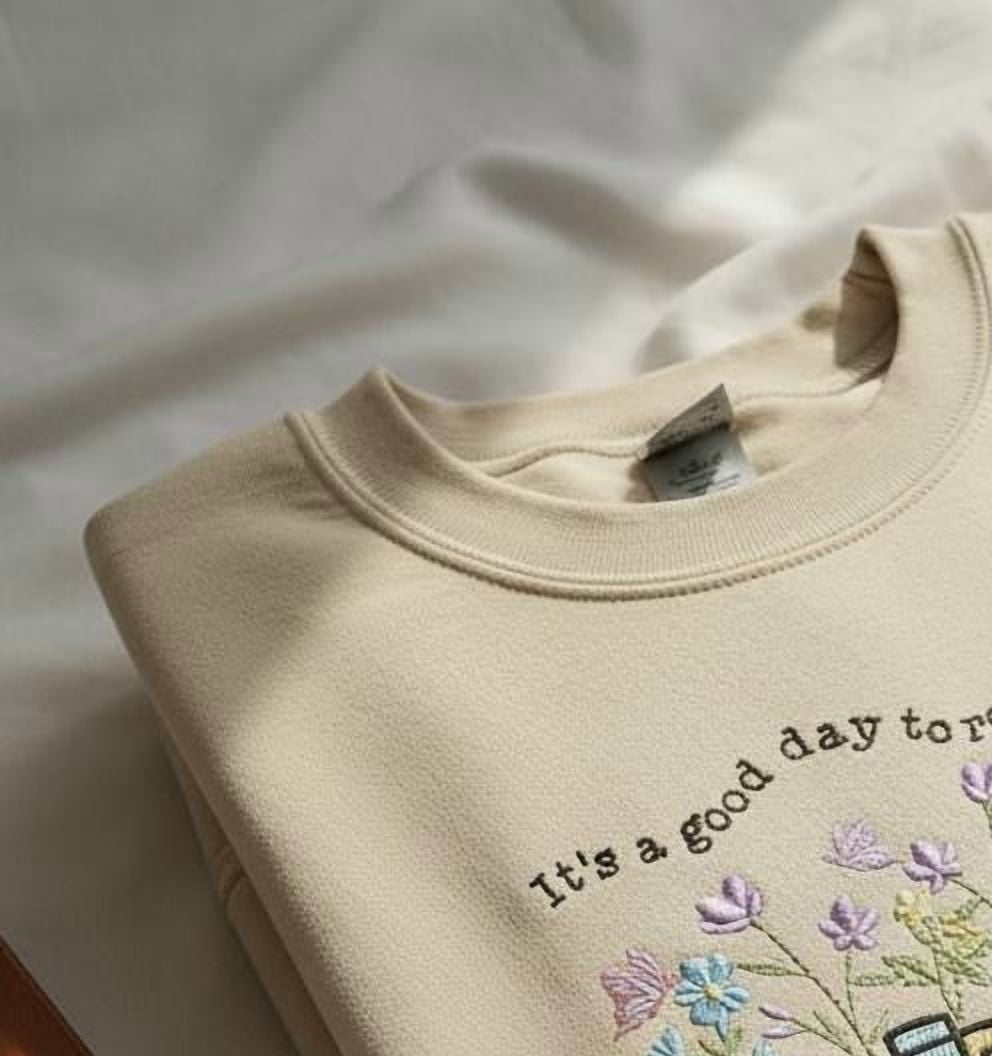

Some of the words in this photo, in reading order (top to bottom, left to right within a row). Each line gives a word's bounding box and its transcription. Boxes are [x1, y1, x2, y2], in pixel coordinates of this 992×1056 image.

[528, 846, 620, 909] It's
[635, 836, 669, 865] a
[679, 758, 775, 855] good
[779, 715, 883, 761] day
[899, 707, 953, 744] to
